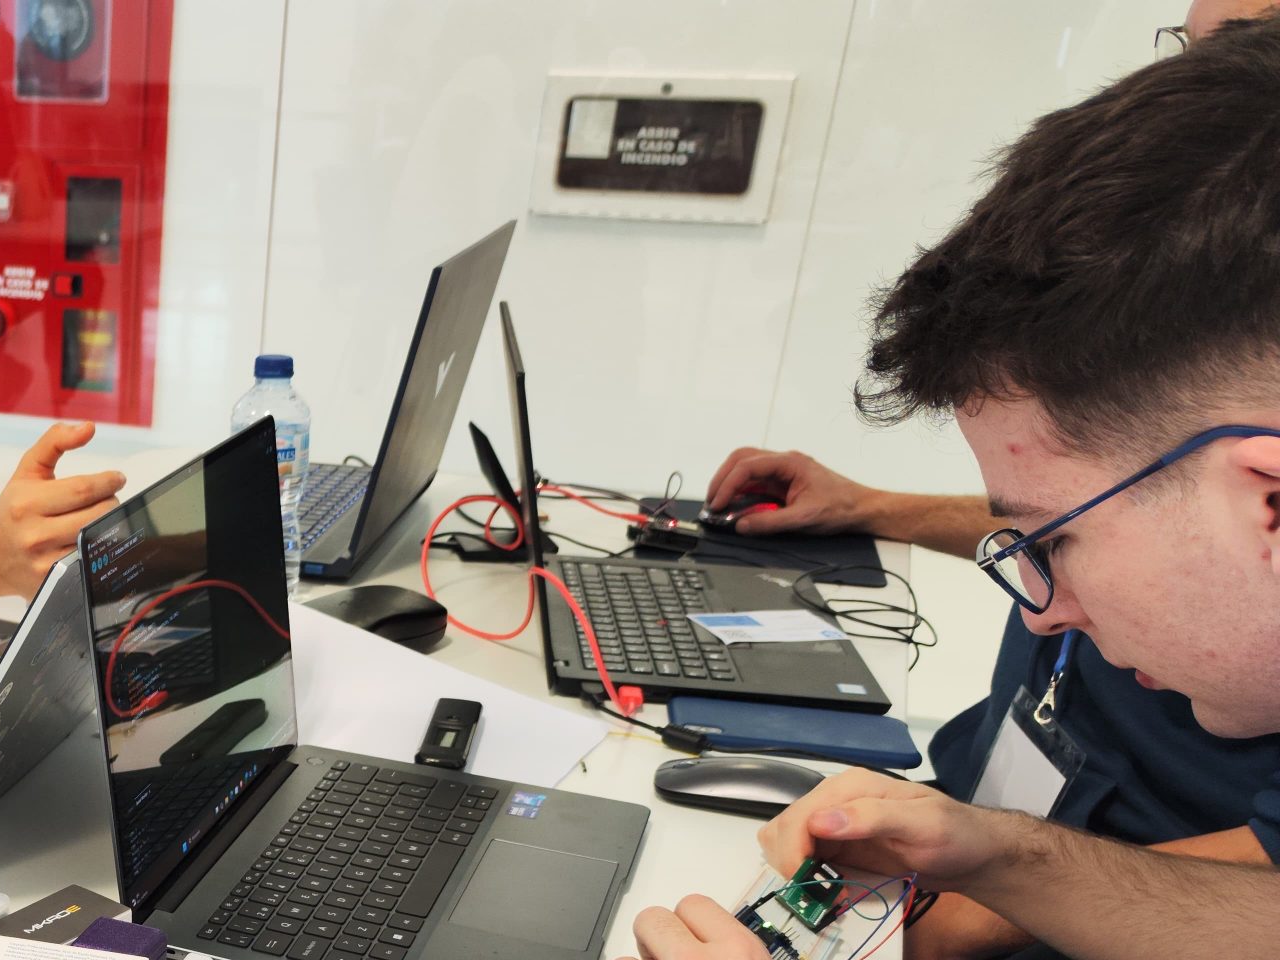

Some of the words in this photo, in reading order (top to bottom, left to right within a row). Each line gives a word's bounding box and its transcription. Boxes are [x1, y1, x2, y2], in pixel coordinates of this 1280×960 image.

[617, 139, 636, 152] EN
[638, 140, 675, 153] CASO
[677, 141, 697, 154] DE
[621, 152, 689, 166] INCENDIO
[23, 904, 81, 934] MIKROE
